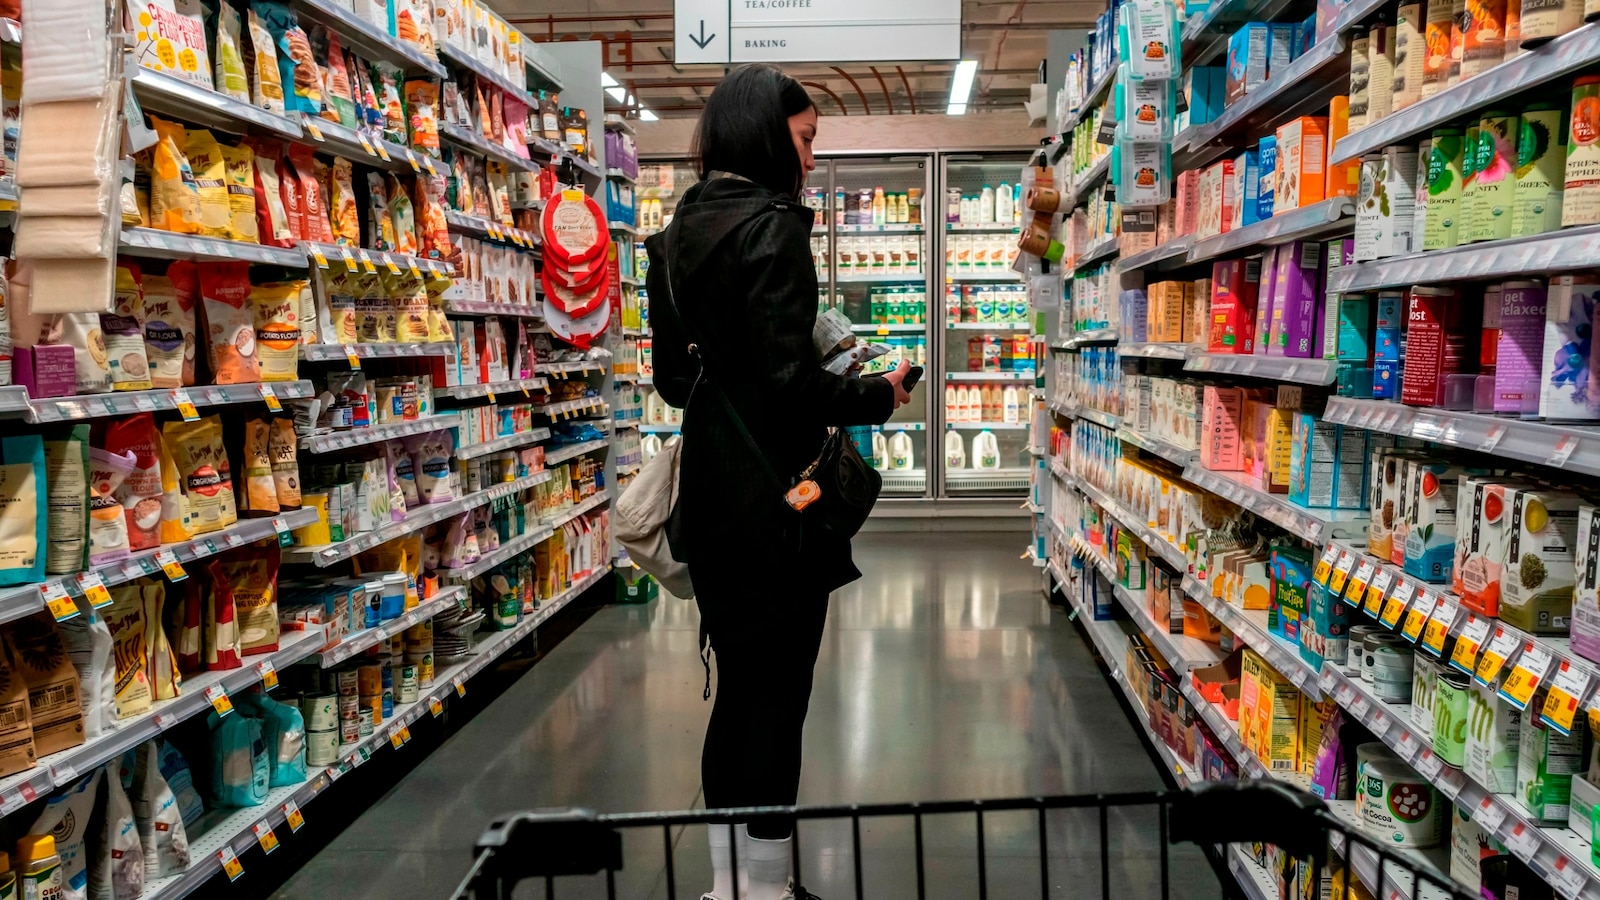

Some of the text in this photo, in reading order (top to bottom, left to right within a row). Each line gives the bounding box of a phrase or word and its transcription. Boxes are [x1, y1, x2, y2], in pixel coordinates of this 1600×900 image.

[745, 0, 812, 9] TEA/COFFEE
[745, 39, 787, 49] BAKING
[1517, 180, 1550, 189] GREEN
[1428, 197, 1457, 205] BOOST
[1504, 291, 1524, 306] get
[44, 365, 69, 373] TORTILLAS
[131, 486, 155, 495] FLOUR
[1473, 490, 1482, 545] NUMI
[1510, 498, 1523, 560] NUMI
[1588, 516, 1600, 581] NUMI
[1367, 779, 1381, 792] 365
[1366, 797, 1383, 810] Organic
[1369, 810, 1392, 823] Cocoa
[42, 885, 62, 897] ORGA
